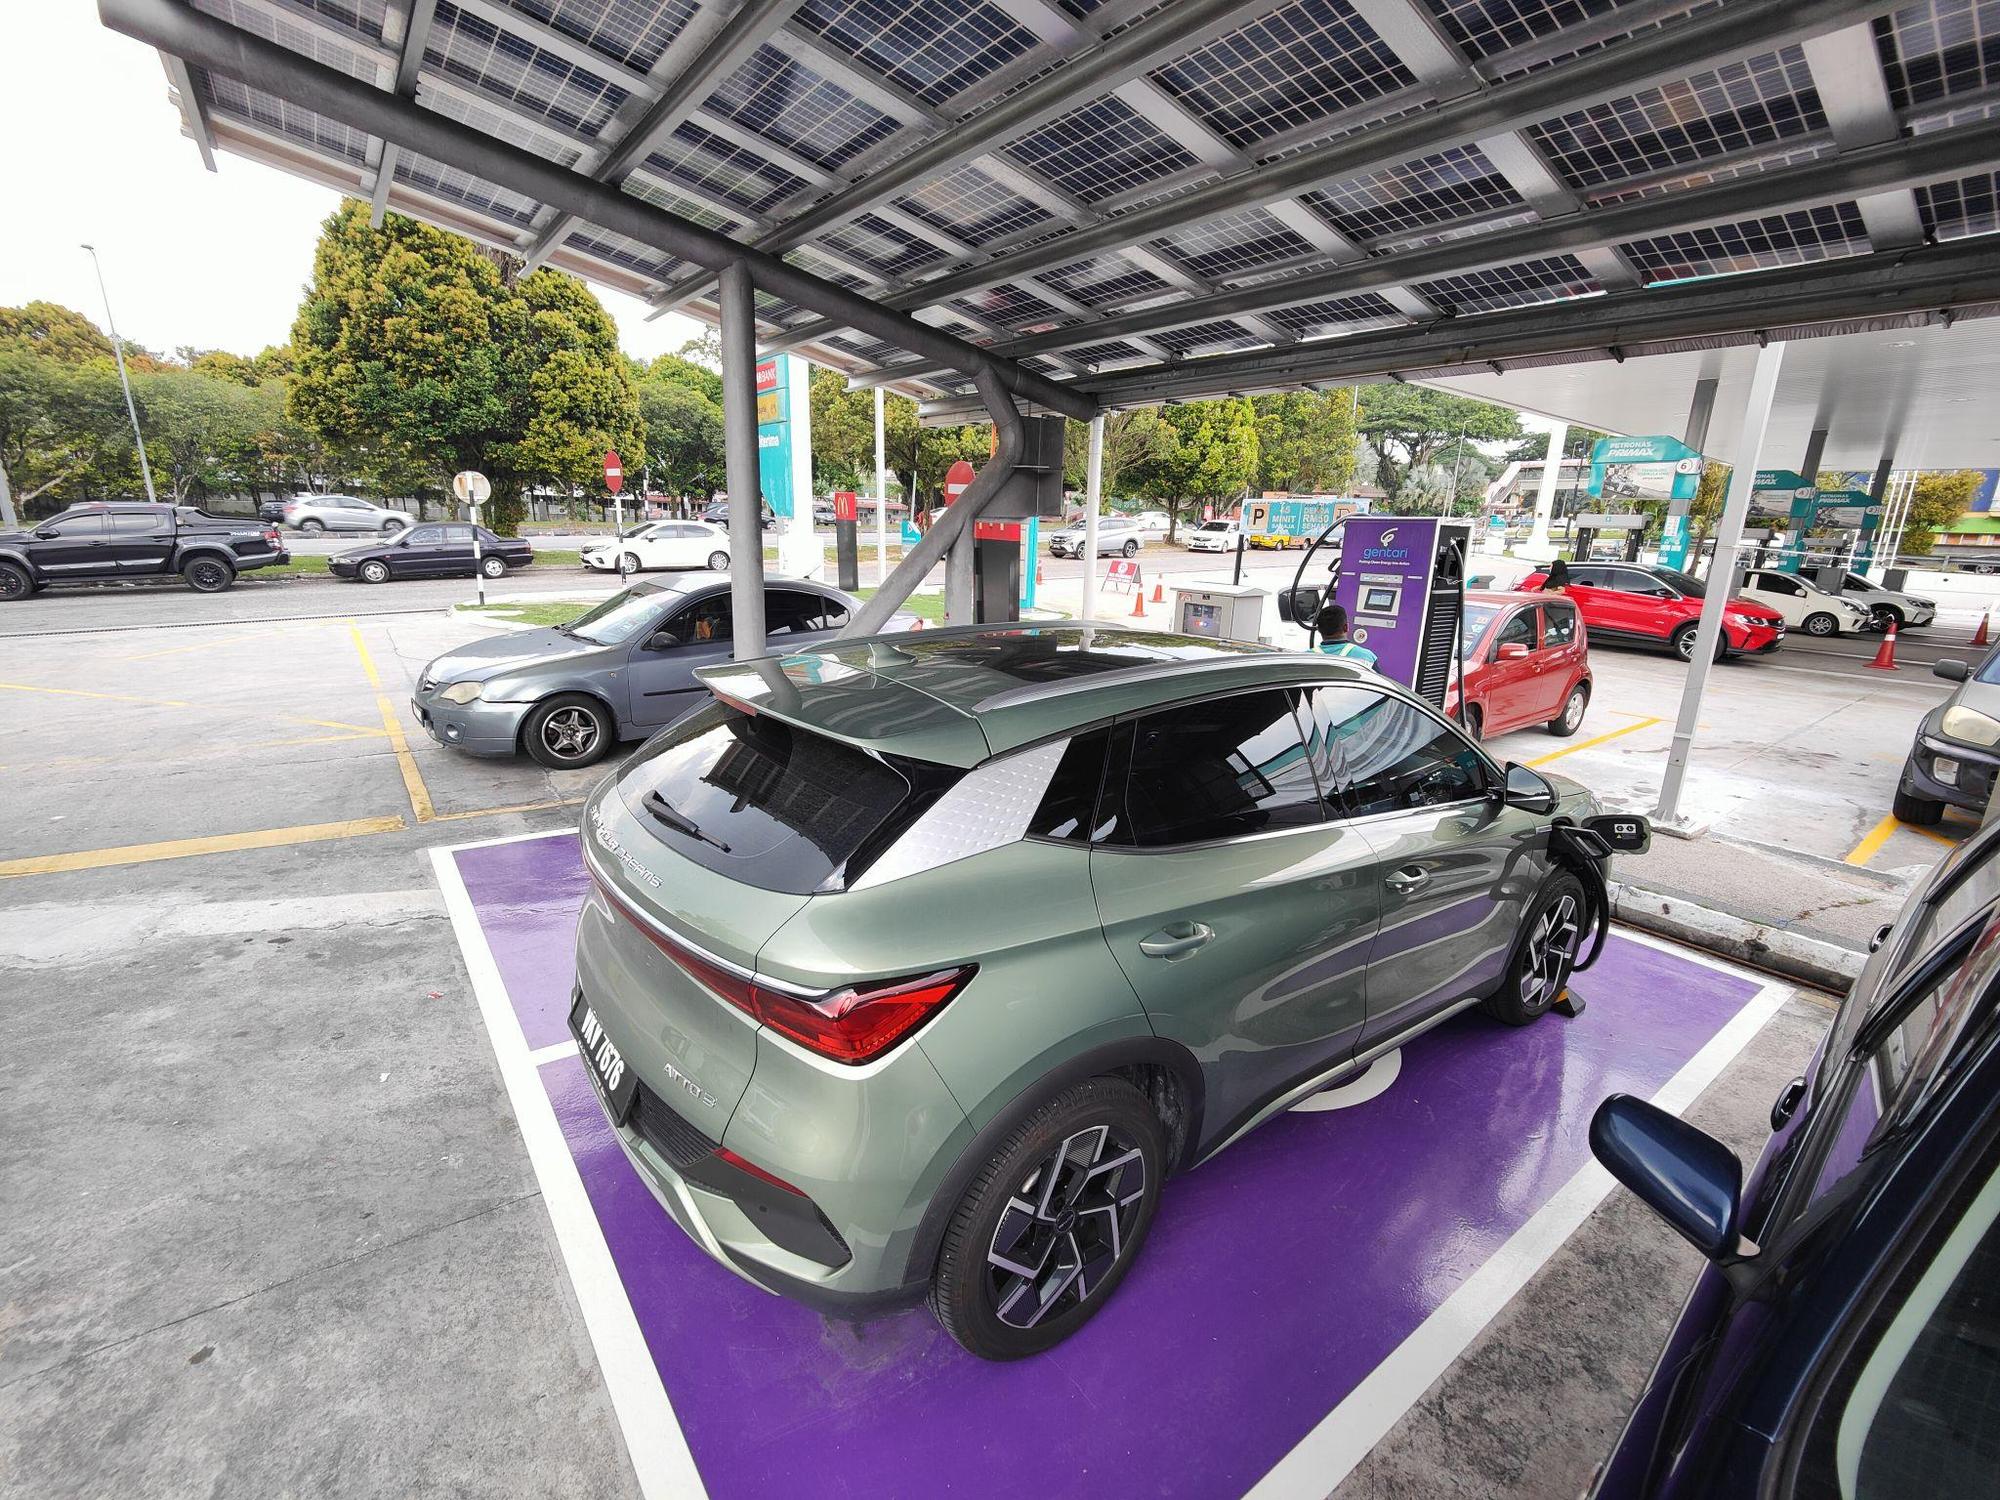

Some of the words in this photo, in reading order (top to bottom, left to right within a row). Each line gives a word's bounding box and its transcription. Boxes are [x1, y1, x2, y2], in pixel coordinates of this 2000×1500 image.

[1609, 441, 1653, 449] PETRONAS
[1607, 448, 1656, 457] PRIMAX
[1680, 462, 1687, 470] 6
[1253, 508, 1265, 525] P
[1363, 547, 1408, 559] gentari
[616, 847, 664, 889] DREAMS
[595, 1033, 625, 1091] 7676
[664, 1062, 701, 1099] ATTO
[702, 1092, 718, 1108] 3
